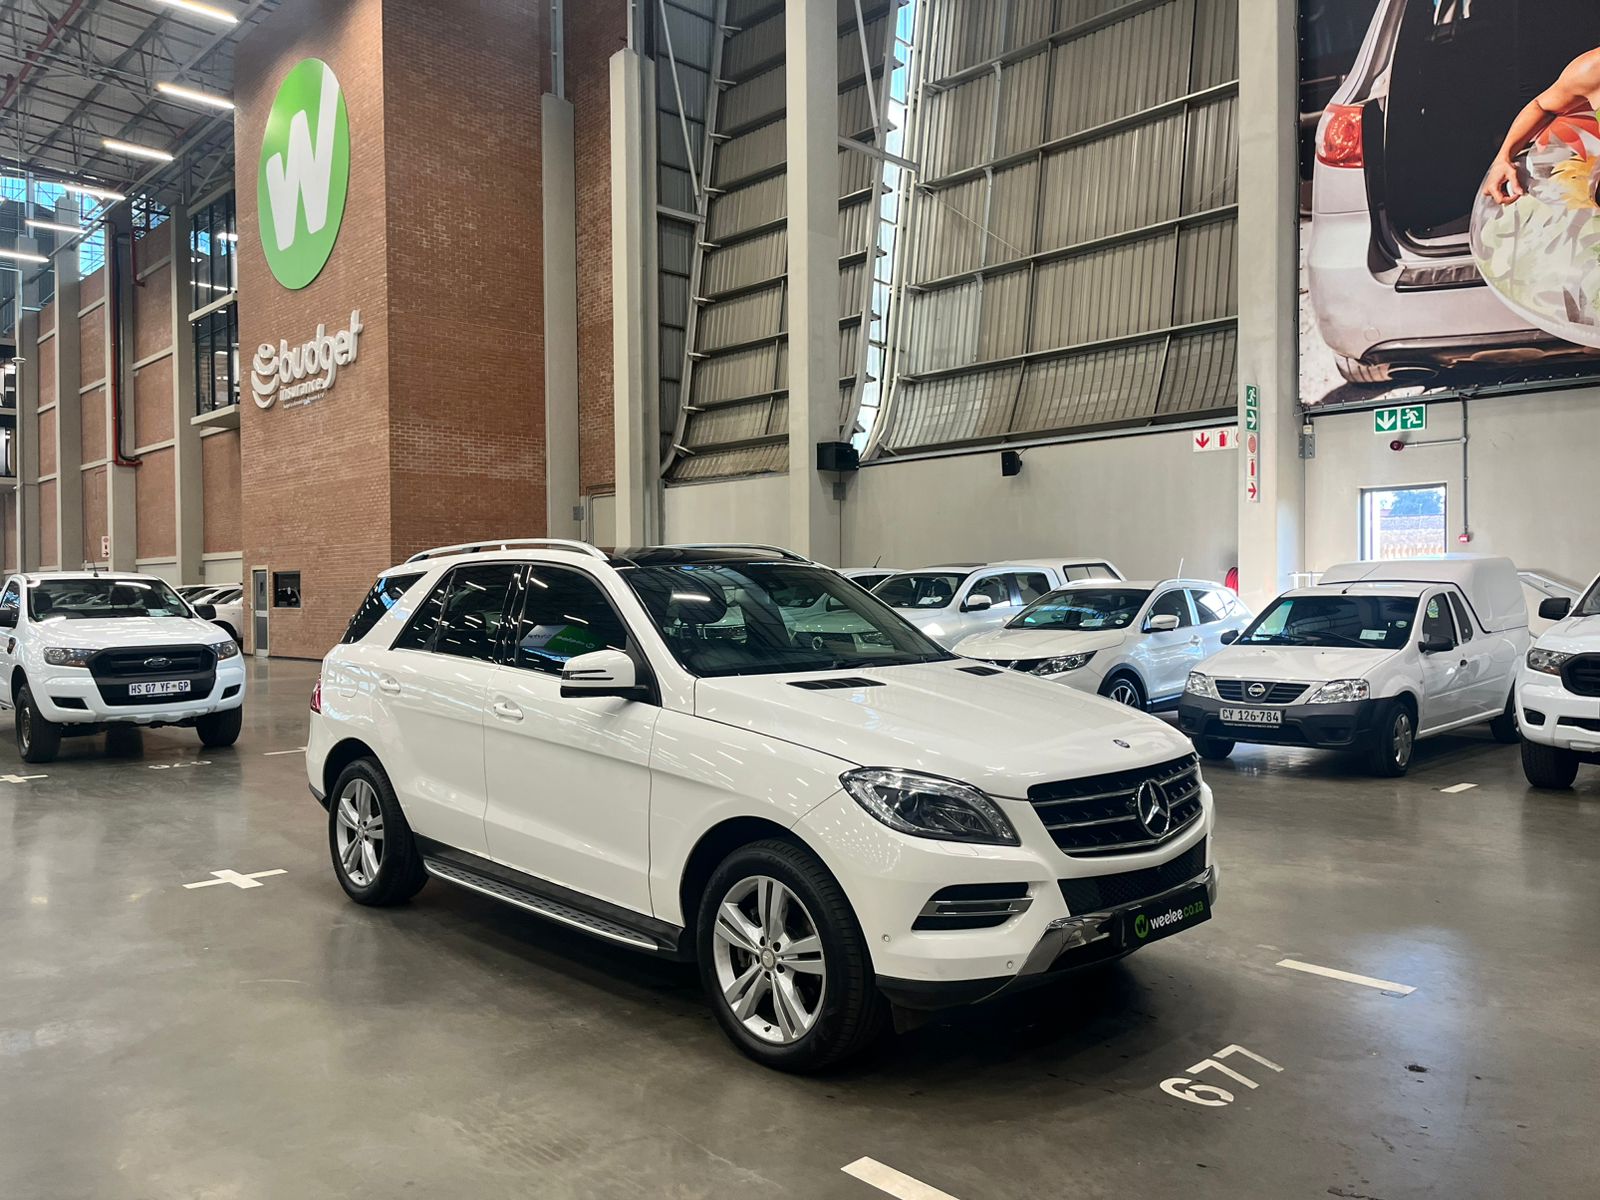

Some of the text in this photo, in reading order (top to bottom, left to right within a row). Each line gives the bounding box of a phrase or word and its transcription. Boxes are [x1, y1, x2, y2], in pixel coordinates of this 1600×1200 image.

[279, 309, 363, 389] budget
[131, 684, 142, 694] HS
[160, 682, 171, 692] YF
[178, 681, 189, 691] GP
[1222, 709, 1234, 719] CY
[1159, 1043, 1285, 1107] 677
